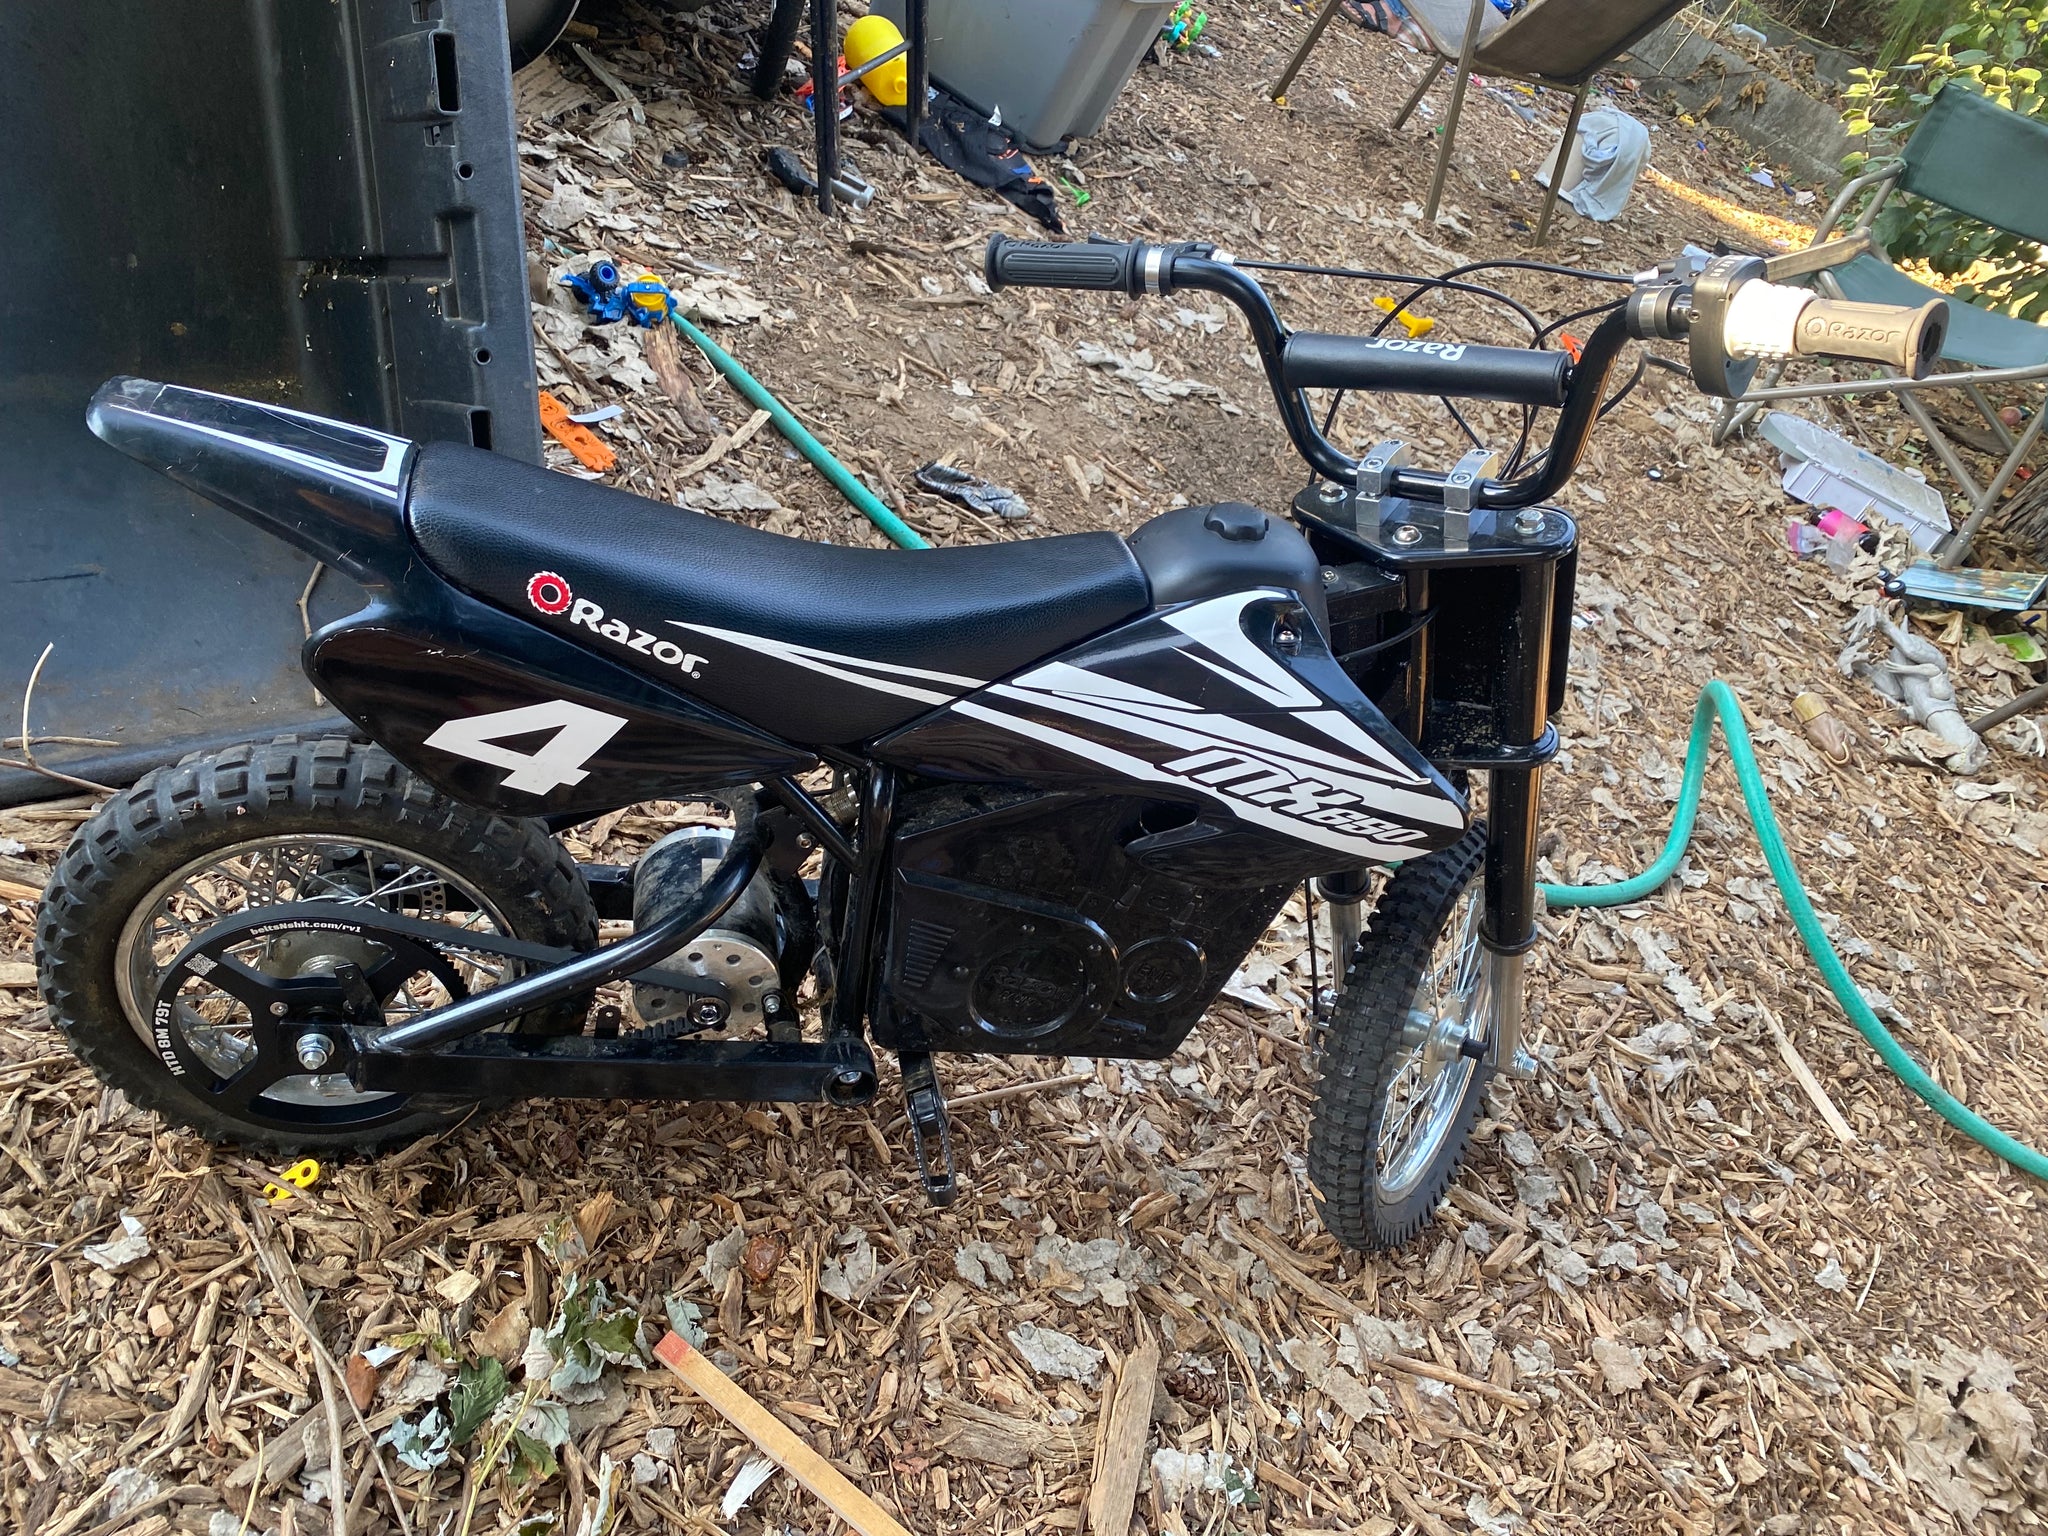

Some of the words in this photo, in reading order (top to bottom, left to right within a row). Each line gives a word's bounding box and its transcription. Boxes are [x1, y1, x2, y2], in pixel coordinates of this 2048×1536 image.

[1827, 321, 1901, 344] Razor
[1365, 338, 1467, 361] Razor
[569, 597, 710, 680] Razor
[423, 699, 629, 796] 4
[250, 920, 361, 936] beltsNshit.com/rv1
[154, 1000, 172, 1025] 79T
[154, 1028, 171, 1048] 8M
[162, 1050, 186, 1076] HTD
